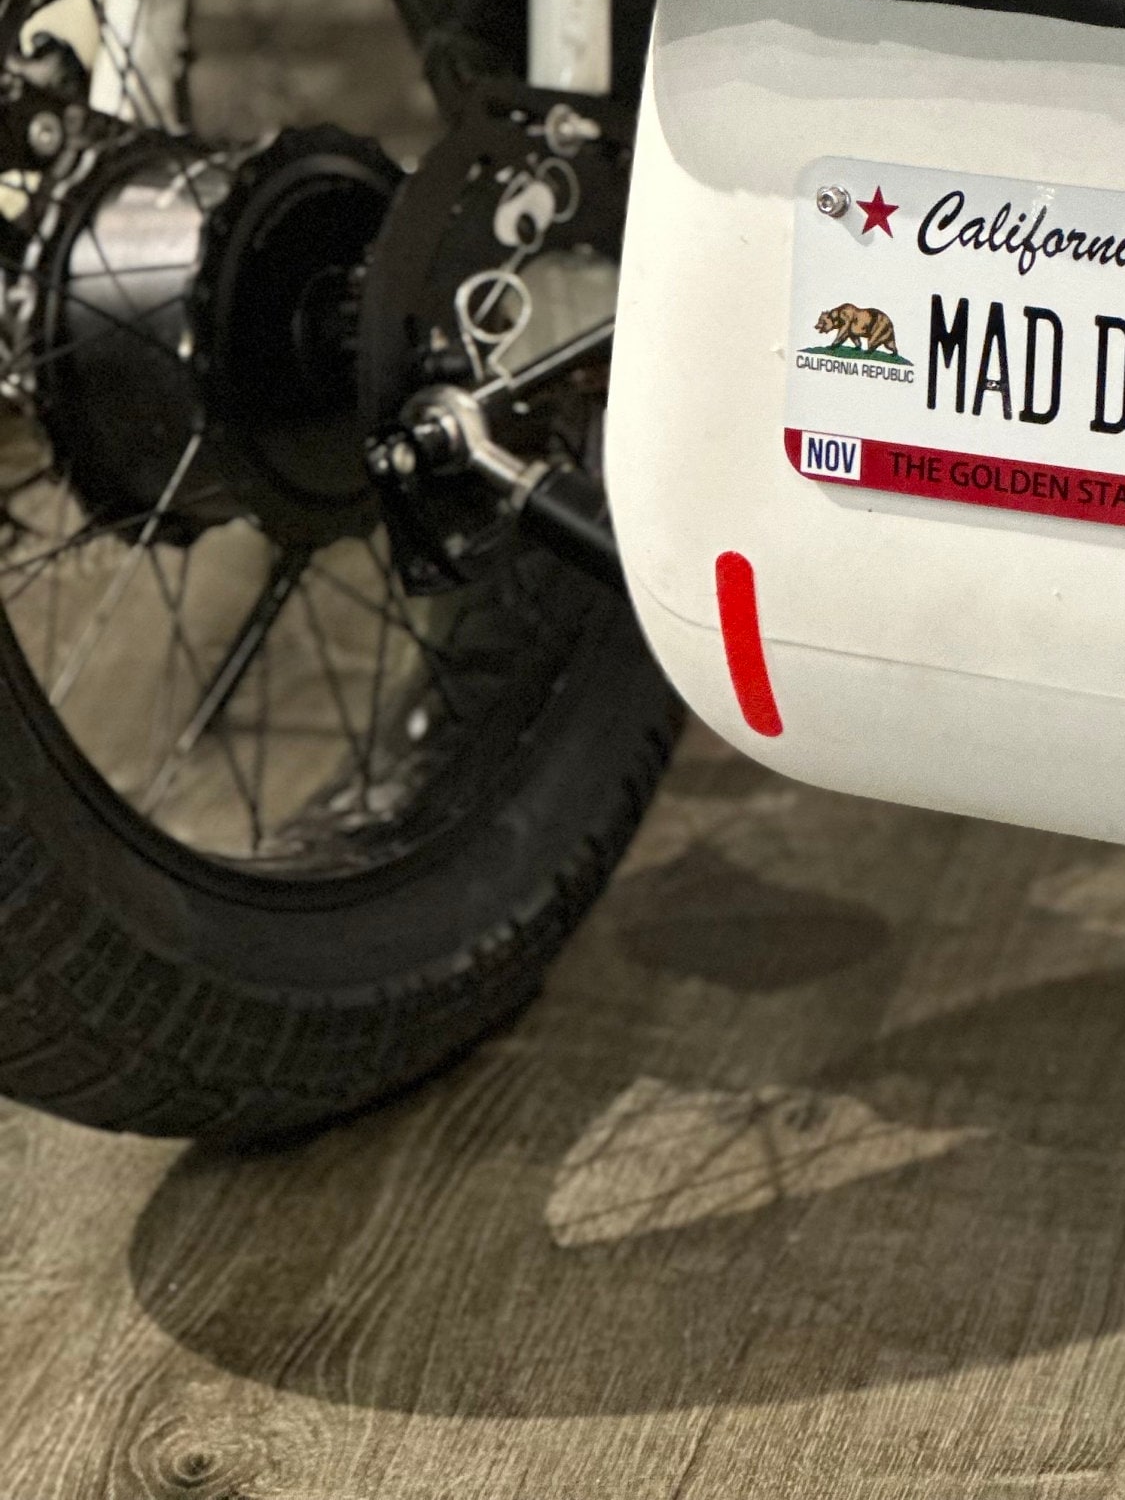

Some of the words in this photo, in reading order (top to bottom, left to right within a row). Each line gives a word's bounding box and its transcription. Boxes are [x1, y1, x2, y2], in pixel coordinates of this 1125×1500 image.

[795, 355, 859, 376] CALIFORNIA
[861, 364, 915, 384] REPUBLIC
[926, 293, 1064, 425] MAD
[806, 437, 857, 474] NOV
[888, 450, 942, 483] THE
[949, 460, 1069, 500] GOLDEN
